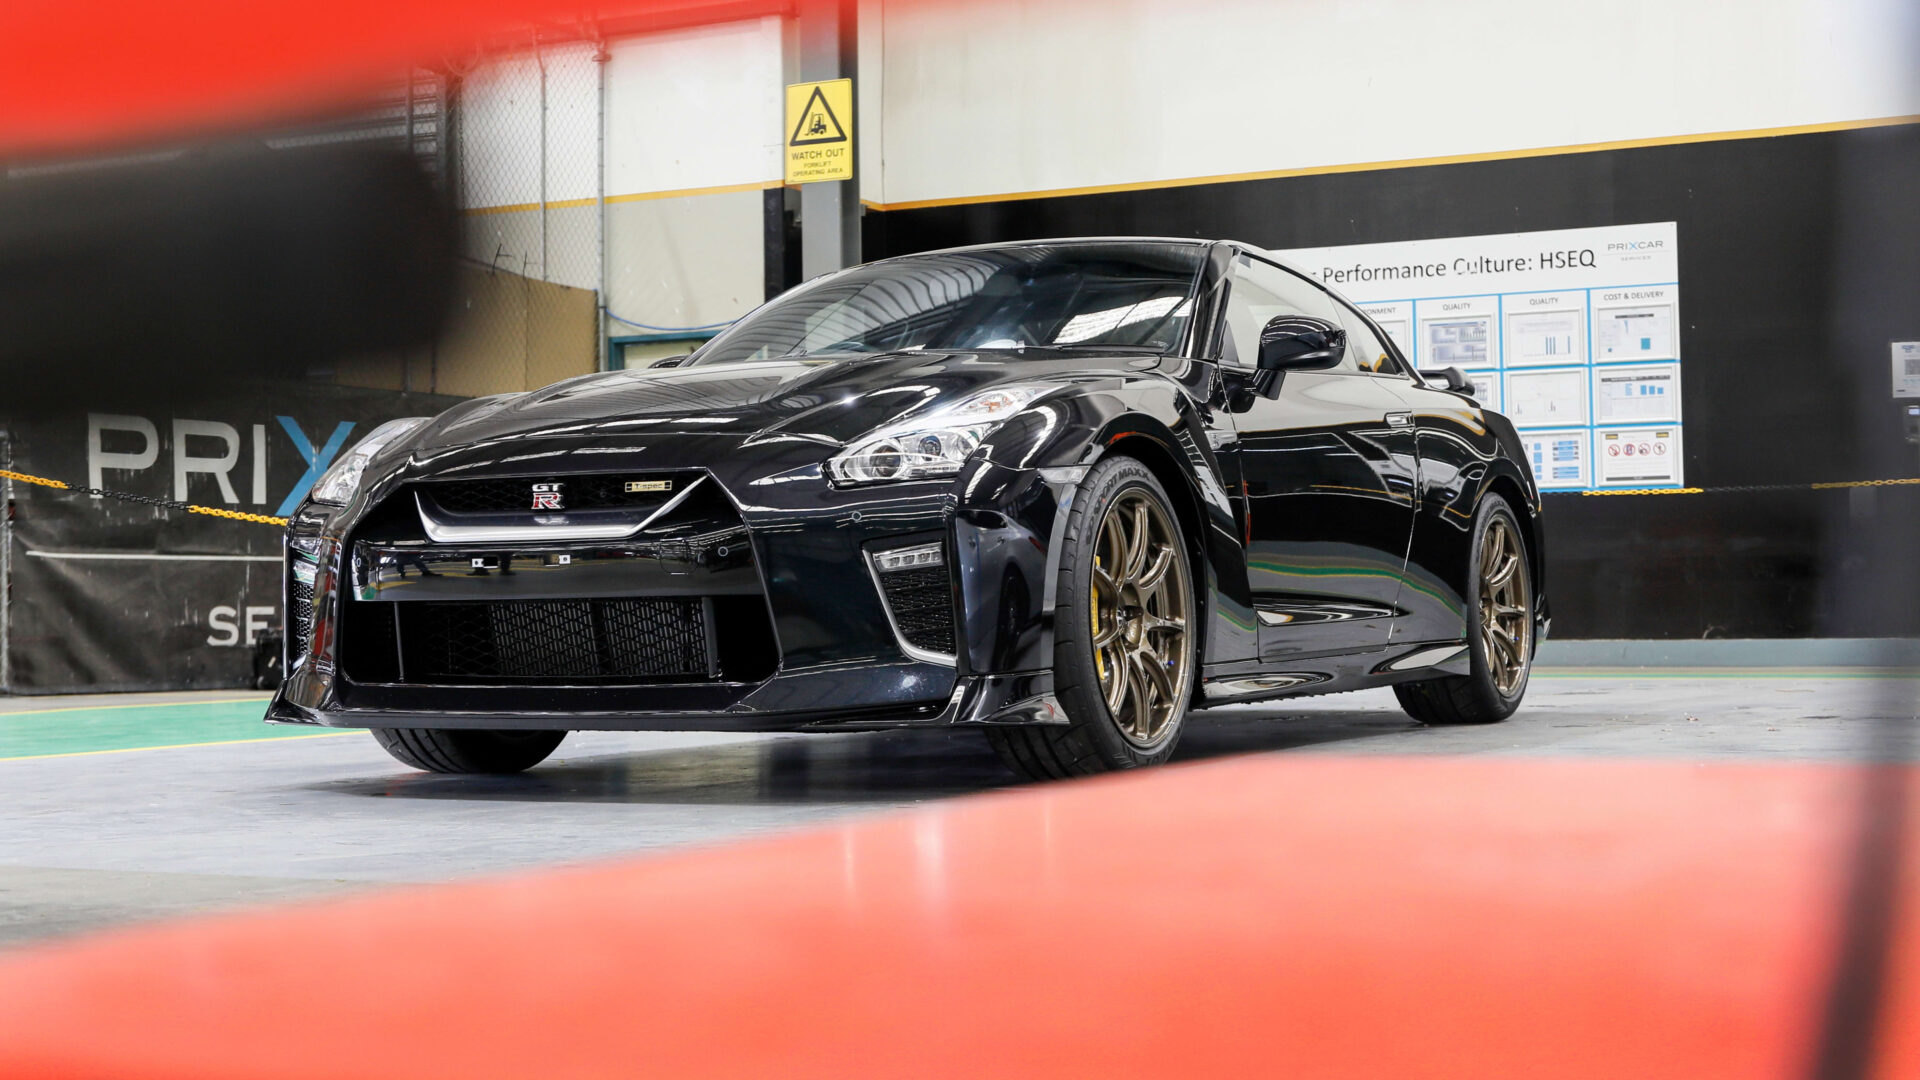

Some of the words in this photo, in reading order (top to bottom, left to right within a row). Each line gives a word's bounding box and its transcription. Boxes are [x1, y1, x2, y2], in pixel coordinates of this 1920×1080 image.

[791, 150, 822, 160] WATCH
[825, 148, 844, 158] OUT
[1607, 240, 1664, 251] PRIXCAR
[1323, 263, 1447, 283] Performance
[1453, 256, 1532, 275] Culture:
[1540, 249, 1597, 270] HSEQ
[1603, 293, 1622, 301] COST
[1624, 292, 1630, 300] &
[1631, 290, 1664, 300] DELIVERY
[1442, 302, 1471, 311] QUALITY
[1529, 297, 1559, 306] QUALITY
[1118, 467, 1150, 481] MAXX
[532, 483, 564, 492] GT
[531, 492, 564, 510] R
